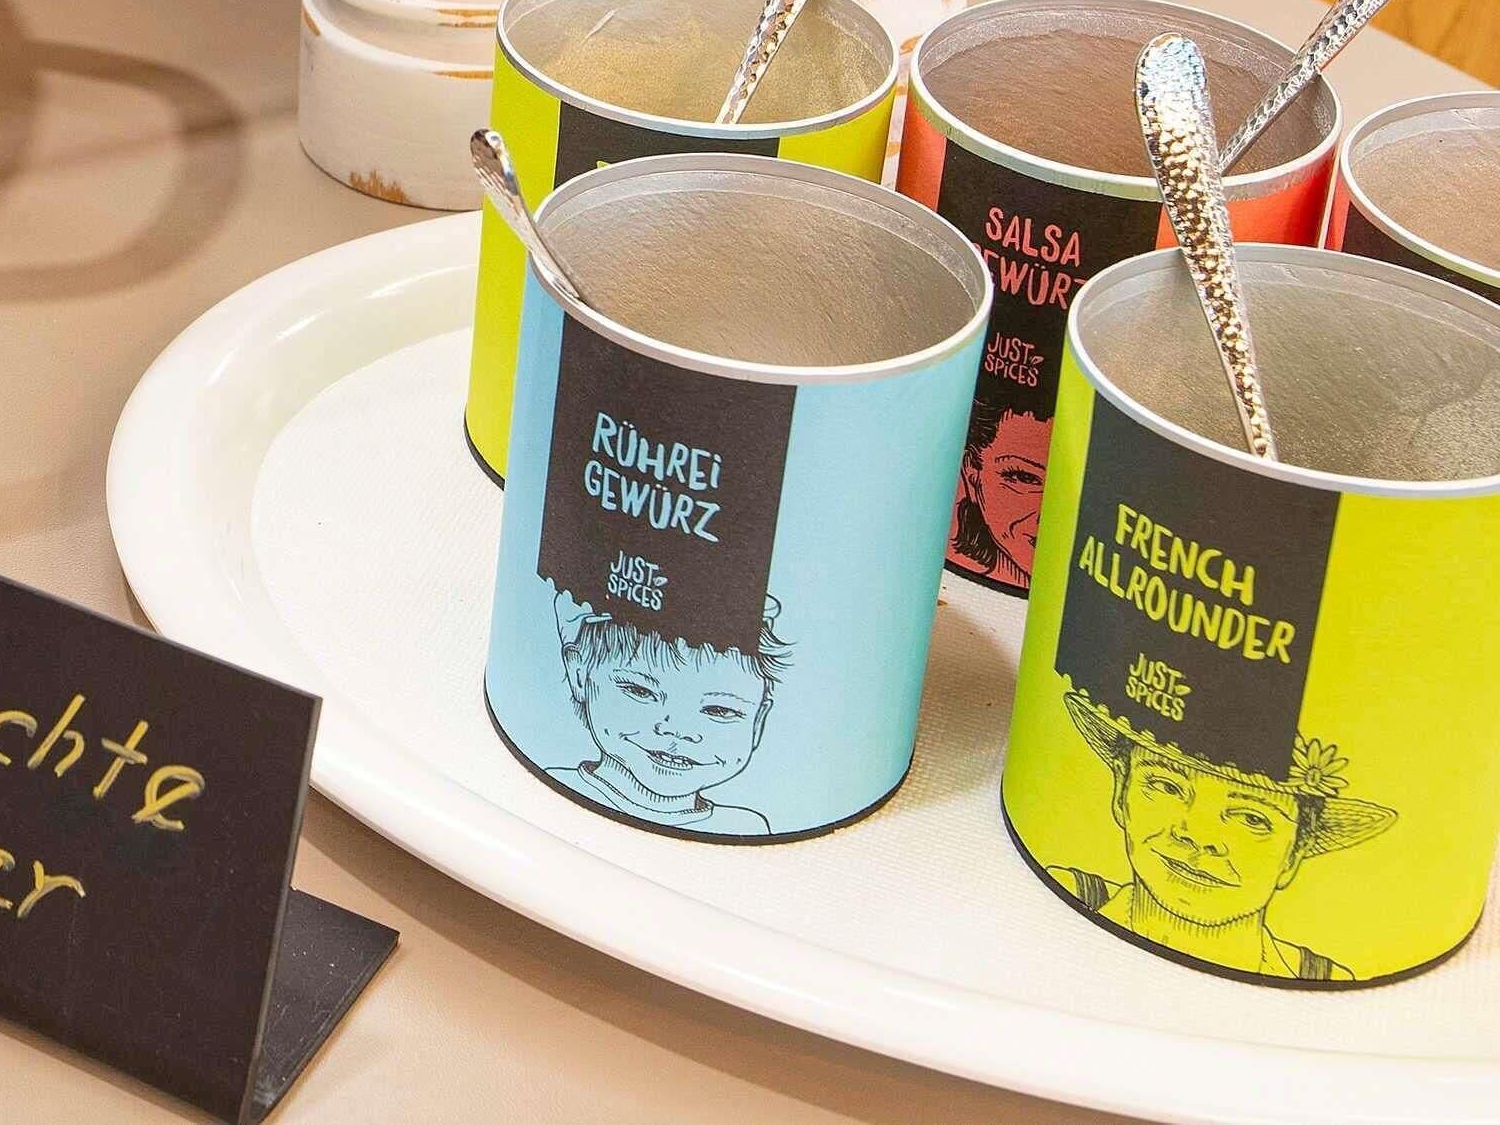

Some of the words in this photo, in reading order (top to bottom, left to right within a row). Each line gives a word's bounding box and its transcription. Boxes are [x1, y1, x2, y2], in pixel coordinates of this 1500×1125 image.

[985, 206, 1082, 268] SALSA
[988, 332, 1035, 365] JUST
[584, 460, 721, 543] GEWÜRZ
[610, 550, 660, 586] JUST
[1115, 503, 1256, 606] FRENCH
[1079, 536, 1296, 664] ALLROUNDER
[1129, 652, 1184, 692] JUST
